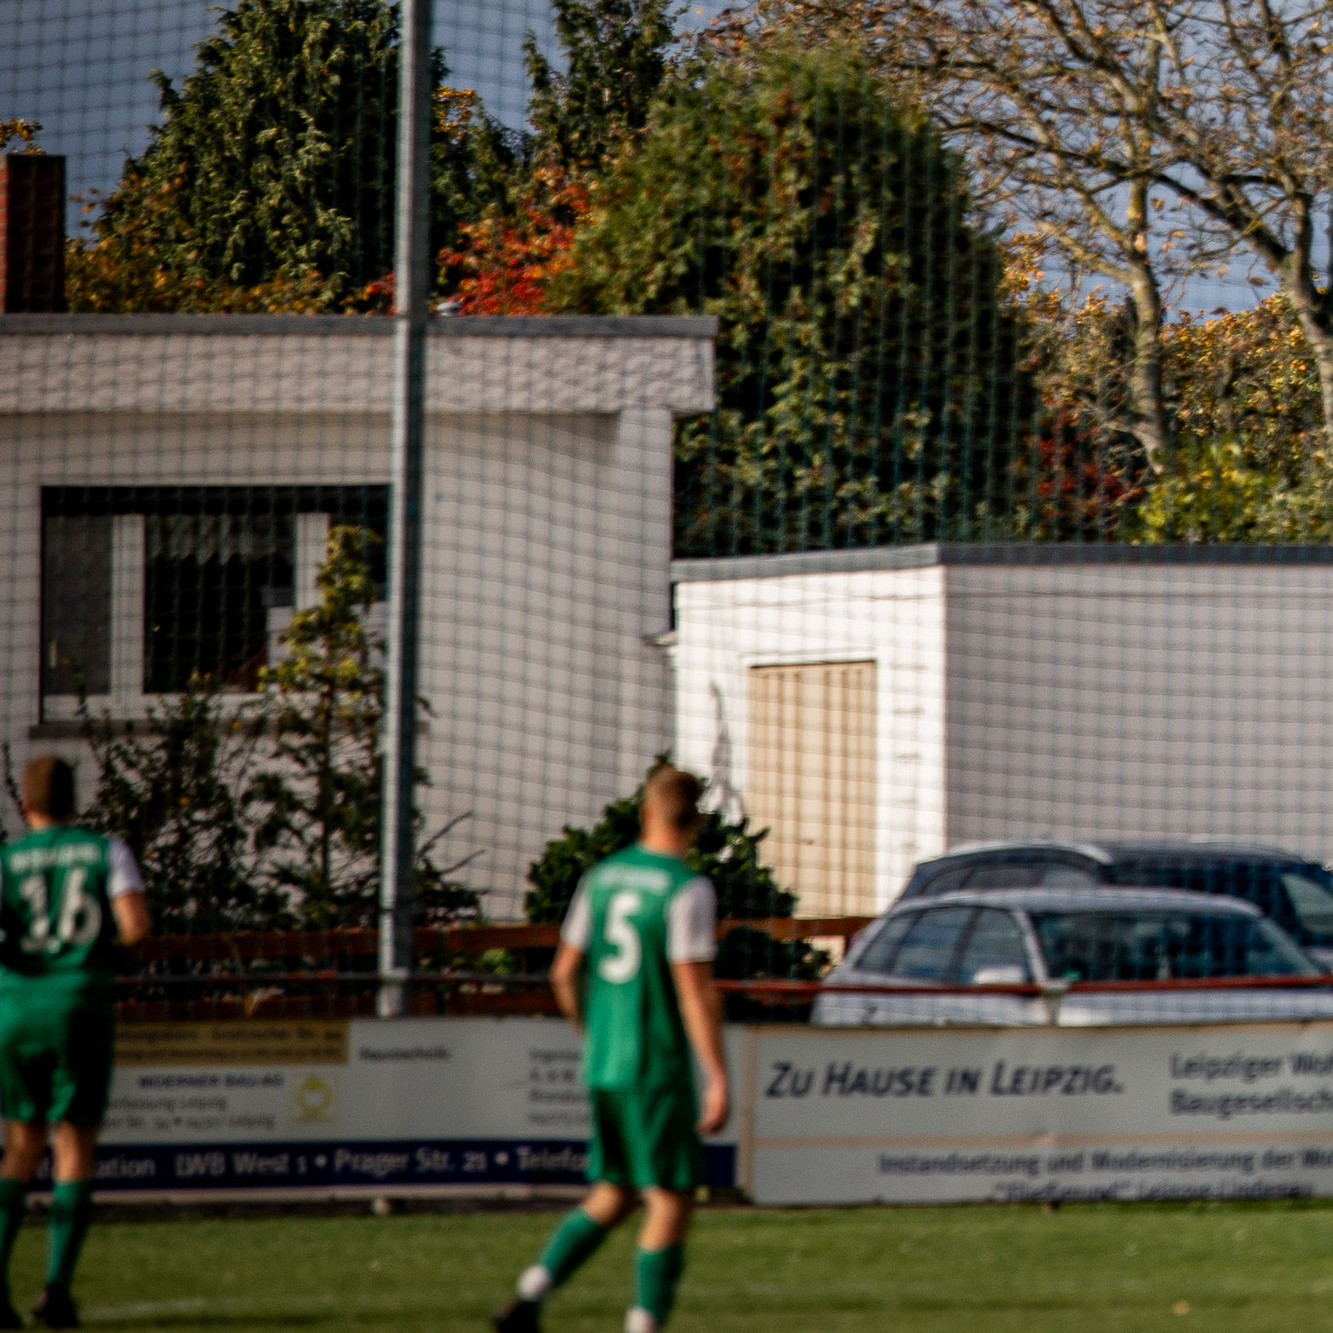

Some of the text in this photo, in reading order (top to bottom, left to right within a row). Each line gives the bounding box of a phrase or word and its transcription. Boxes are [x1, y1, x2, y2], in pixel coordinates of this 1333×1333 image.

[20, 867, 103, 954] 16
[597, 891, 643, 985] 5
[1169, 1052, 1282, 1082] Leipziger
[334, 1147, 409, 1179] Prager
[415, 1146, 455, 1172] Str.
[1050, 1151, 1085, 1173] und
